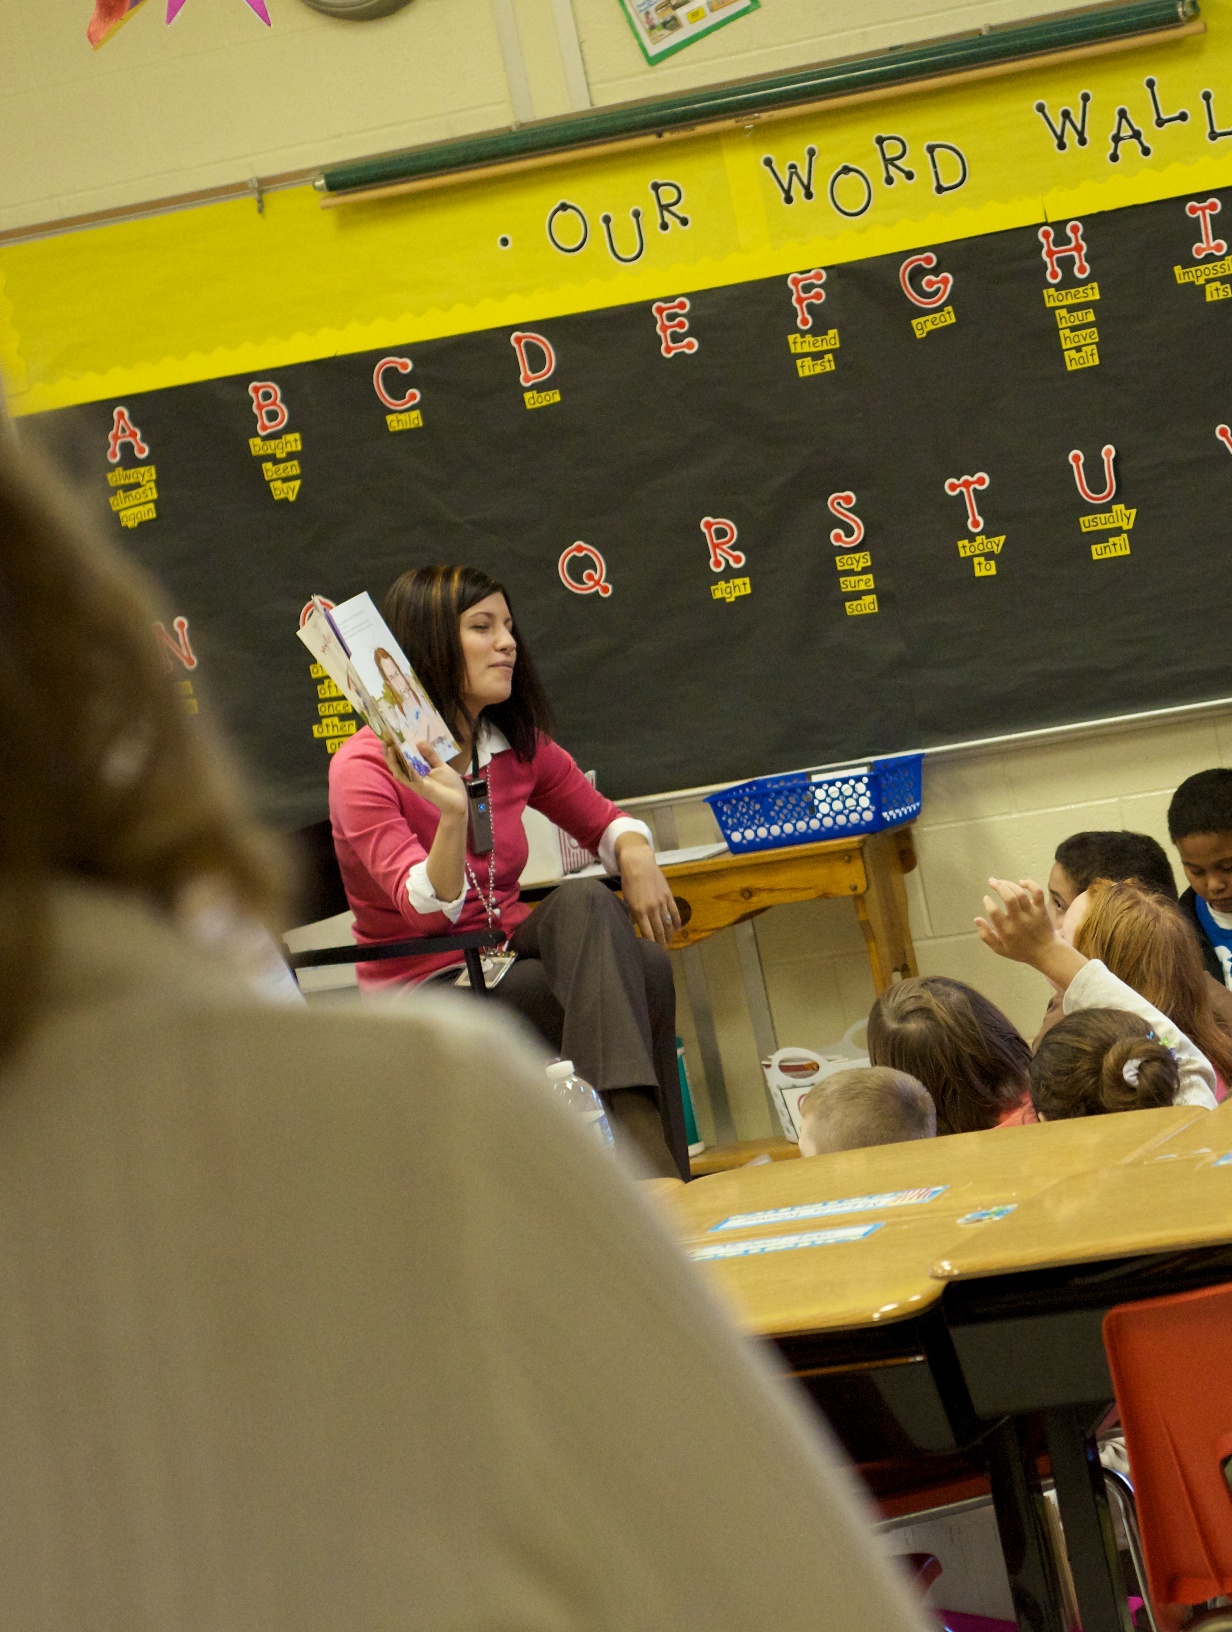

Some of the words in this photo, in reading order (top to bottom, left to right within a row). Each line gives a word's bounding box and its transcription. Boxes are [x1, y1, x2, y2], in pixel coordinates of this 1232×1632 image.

[548, 181, 689, 262] OUR
[763, 134, 968, 217] WORD
[1186, 198, 1227, 259] I
[1038, 220, 1090, 283] H
[900, 253, 953, 307] G
[788, 269, 826, 328] F
[1045, 284, 1096, 304] honest
[1209, 283, 1231, 299] its
[652, 297, 698, 358] E
[915, 308, 954, 335] great
[1058, 310, 1093, 326] hour
[791, 332, 838, 351] friend
[1062, 329, 1097, 346] have
[511, 332, 554, 386] D
[799, 356, 834, 375] first
[1067, 349, 1098, 368] half
[373, 356, 421, 410] C
[249, 381, 287, 435] B
[527, 390, 559, 406] door
[388, 412, 420, 429] child
[107, 406, 149, 462] A
[251, 435, 300, 456] bought
[110, 466, 154, 484] always
[265, 462, 299, 478] been
[1068, 444, 1117, 504] U
[111, 485, 156, 506] almost
[272, 482, 299, 499] buy
[944, 472, 990, 533] T
[121, 506, 155, 526] again
[828, 490, 864, 548] S
[1082, 507, 1132, 529] usually
[700, 516, 745, 572] R
[961, 538, 1001, 554] today
[1095, 537, 1128, 556] until
[558, 541, 612, 597] Q
[838, 554, 869, 570] says
[977, 560, 992, 572] to
[712, 580, 749, 599] right
[841, 577, 872, 590] sure
[847, 598, 876, 613] said
[320, 702, 349, 714] once
[317, 721, 354, 735] other
